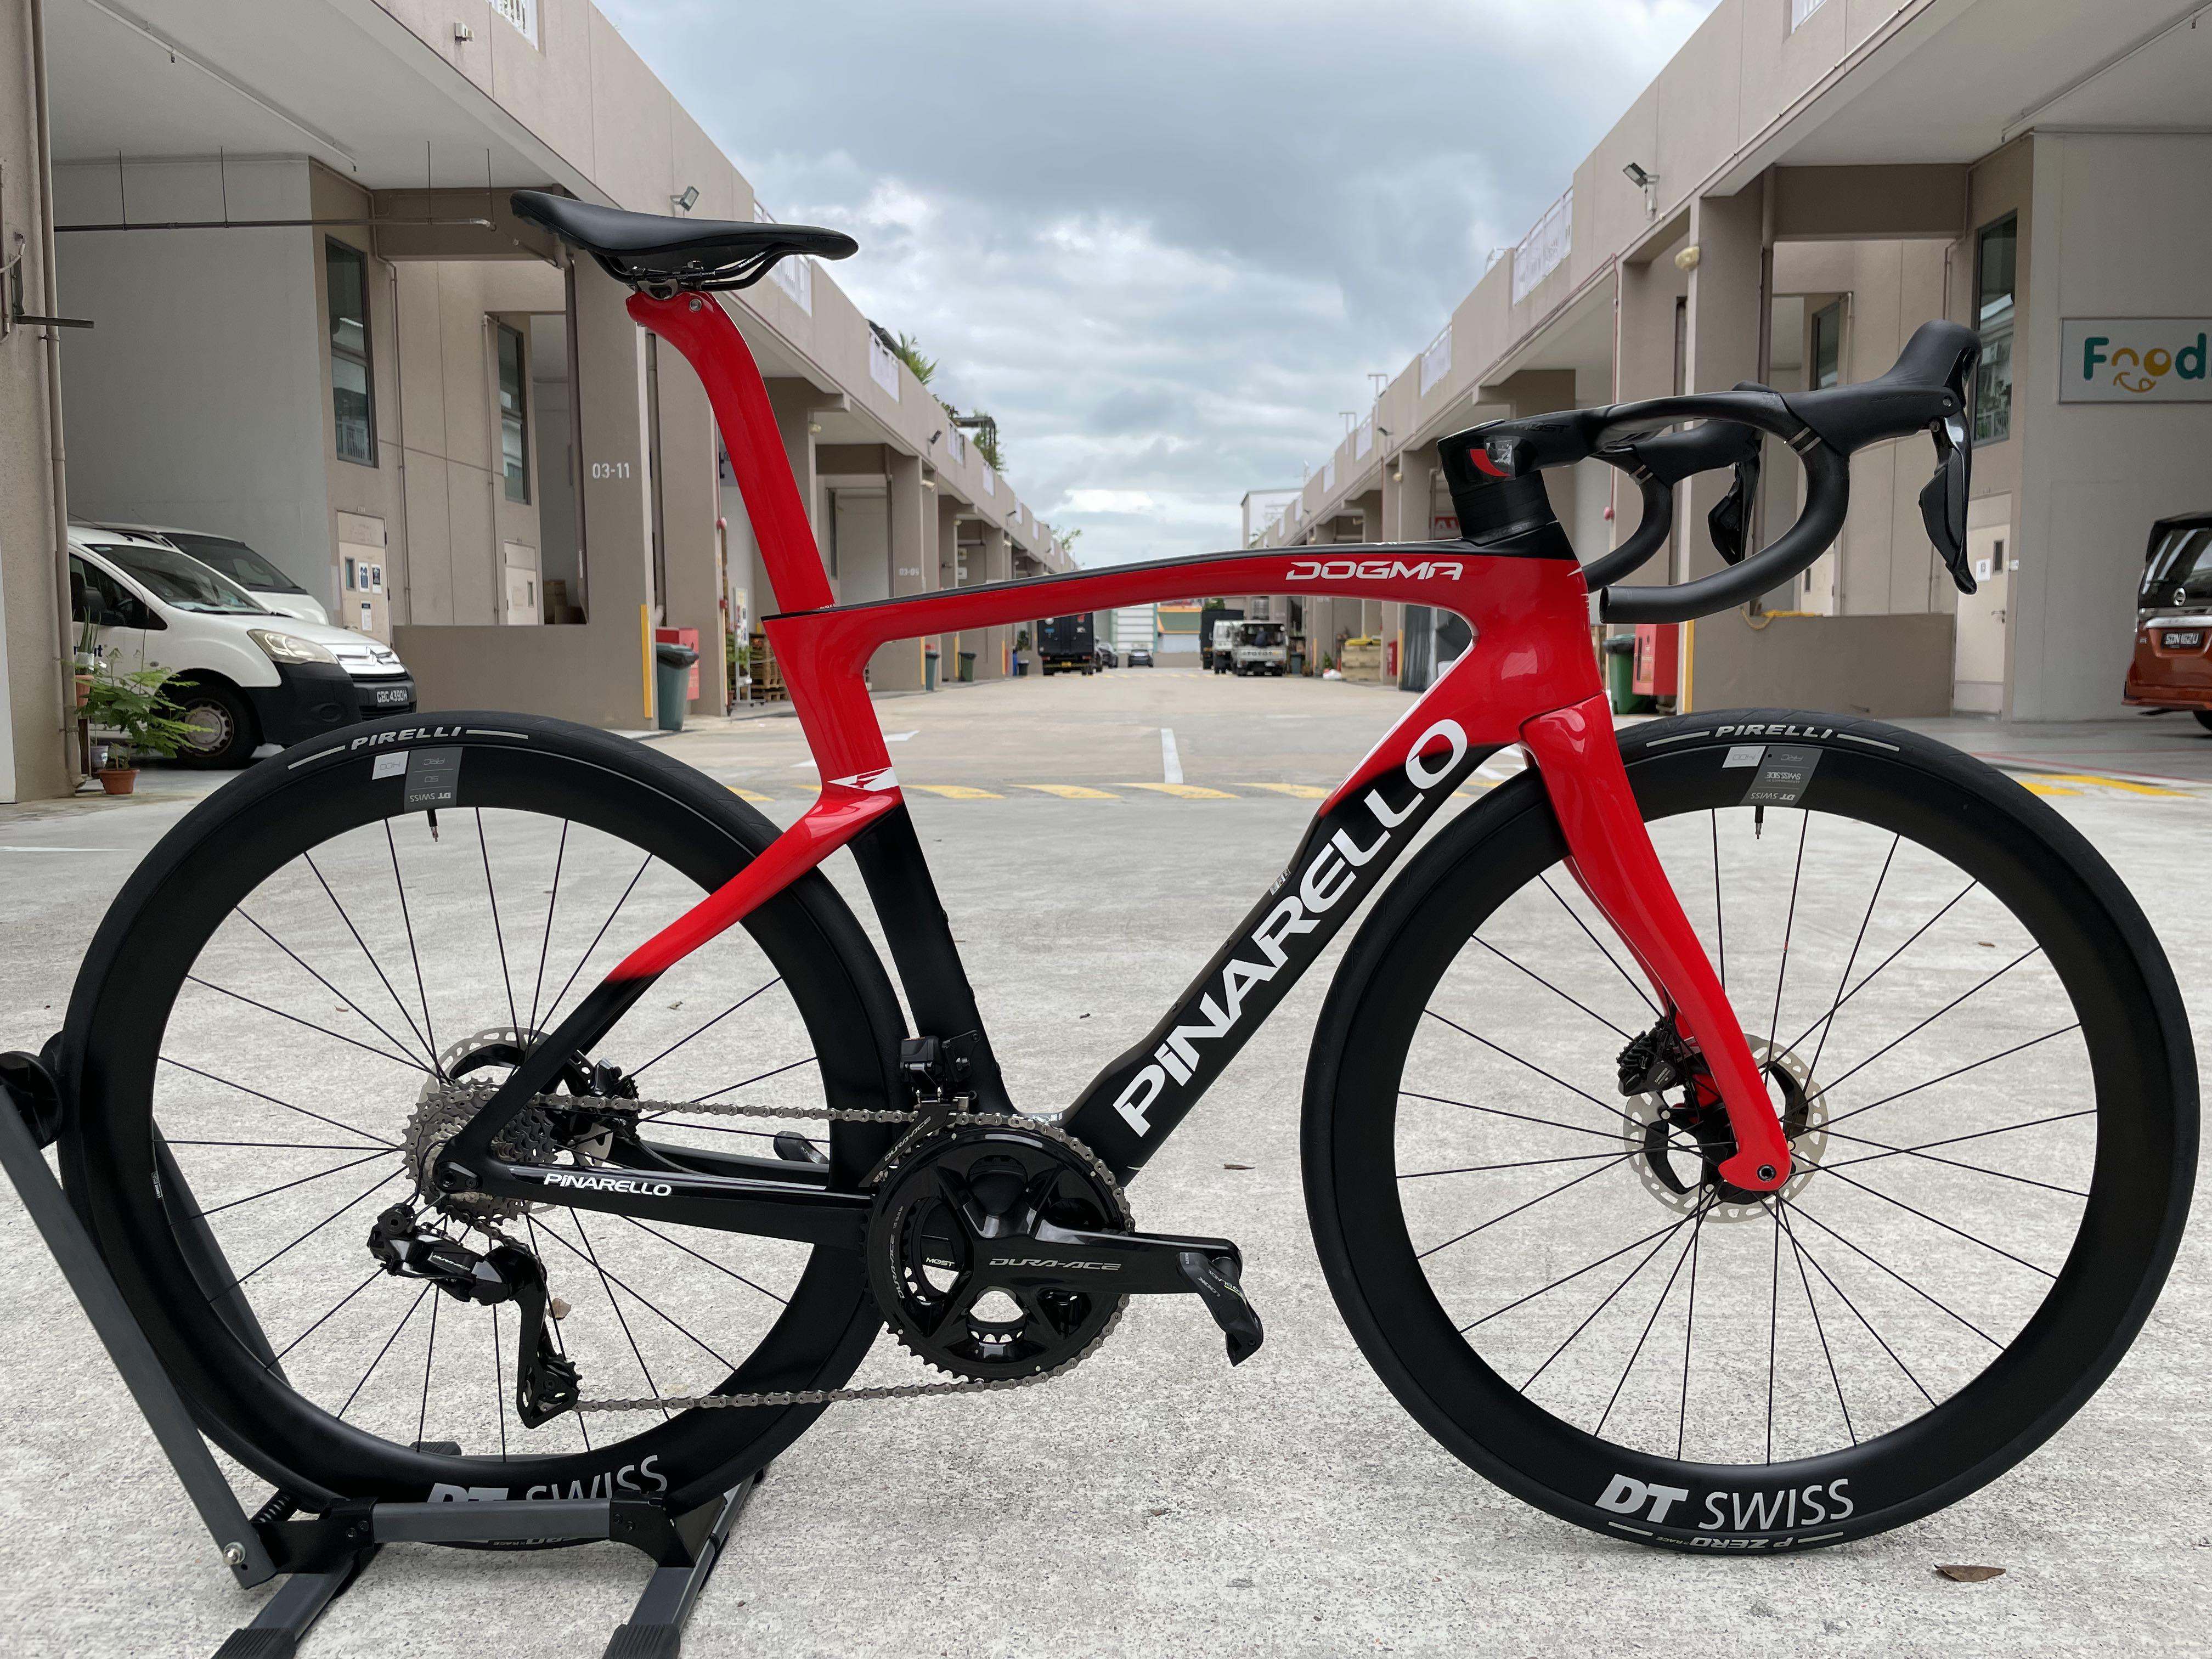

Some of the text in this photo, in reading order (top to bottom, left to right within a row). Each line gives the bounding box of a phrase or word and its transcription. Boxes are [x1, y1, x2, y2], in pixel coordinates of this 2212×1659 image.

[2084, 332, 2212, 380] Food
[592, 462, 630, 479] 03-11
[1285, 561, 1464, 580] DOGMA
[376, 689, 408, 704] GBC4390H
[351, 726, 461, 751] PIRELLI
[1715, 724, 1833, 739] PIRELLI
[424, 757, 445, 765] ARC
[1781, 754, 1804, 762] ARC
[409, 792, 435, 803] SWISS
[1750, 792, 1796, 801] DT SWISS
[884, 1115, 932, 1161] DURA-ACE
[989, 1258, 1122, 1271] DURA-ACE
[1197, 1277, 1221, 1298] LOOK
[1594, 1473, 1854, 1531] DT SWISS
[1689, 1537, 1769, 1549] ZERO
[1773, 1537, 1794, 1548] P
